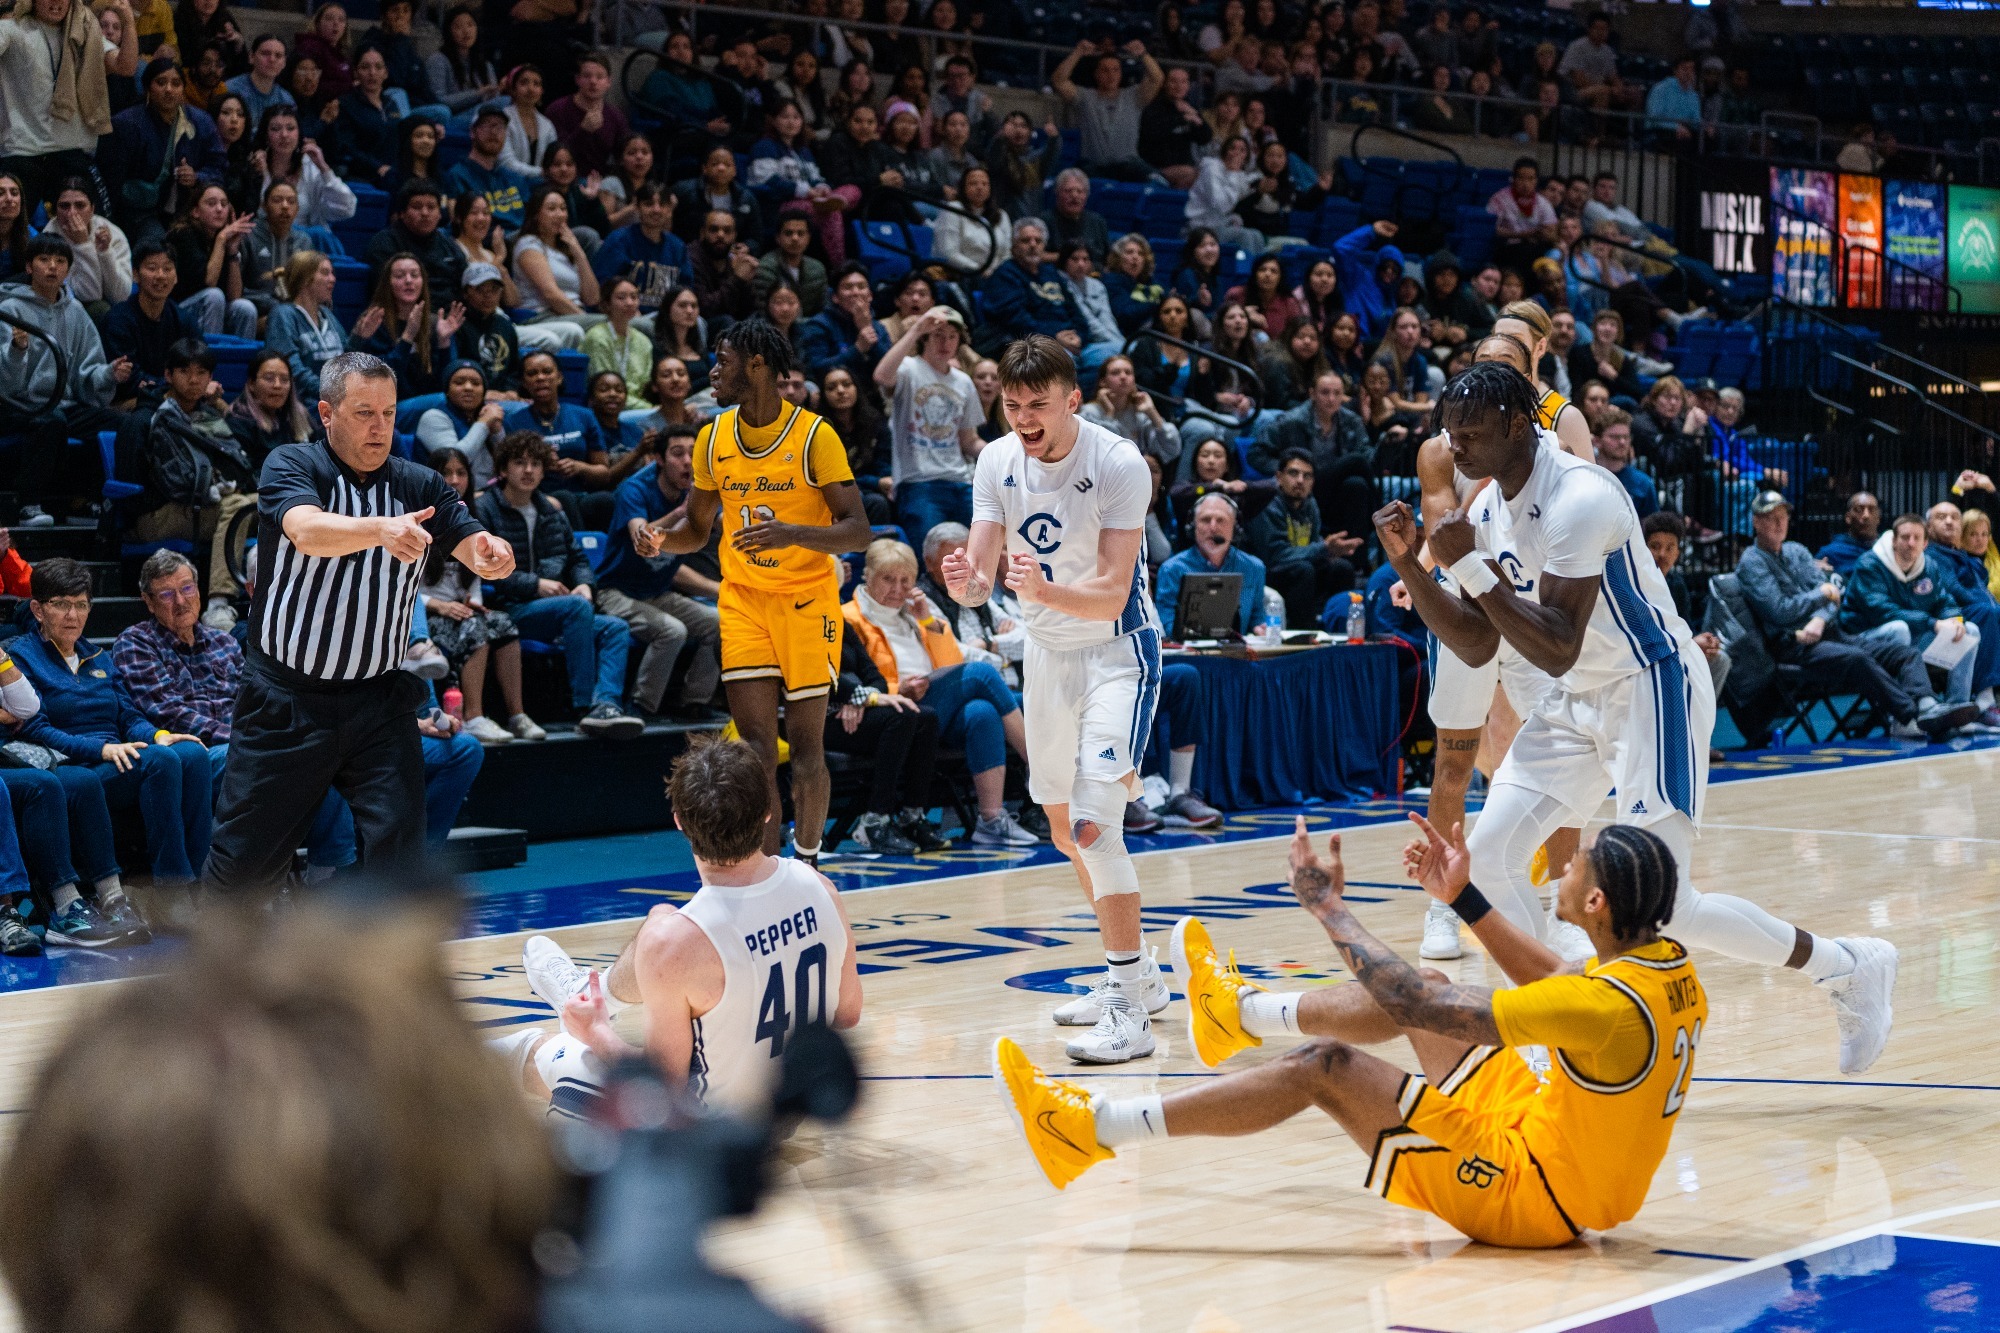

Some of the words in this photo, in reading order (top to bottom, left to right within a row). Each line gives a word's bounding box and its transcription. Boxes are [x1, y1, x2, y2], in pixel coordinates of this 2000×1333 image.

[722, 475, 751, 497] Long
[755, 476, 796, 491] Beach
[747, 553, 780, 568] State
[745, 906, 818, 961] PEPPER
[755, 942, 827, 1059] 40
